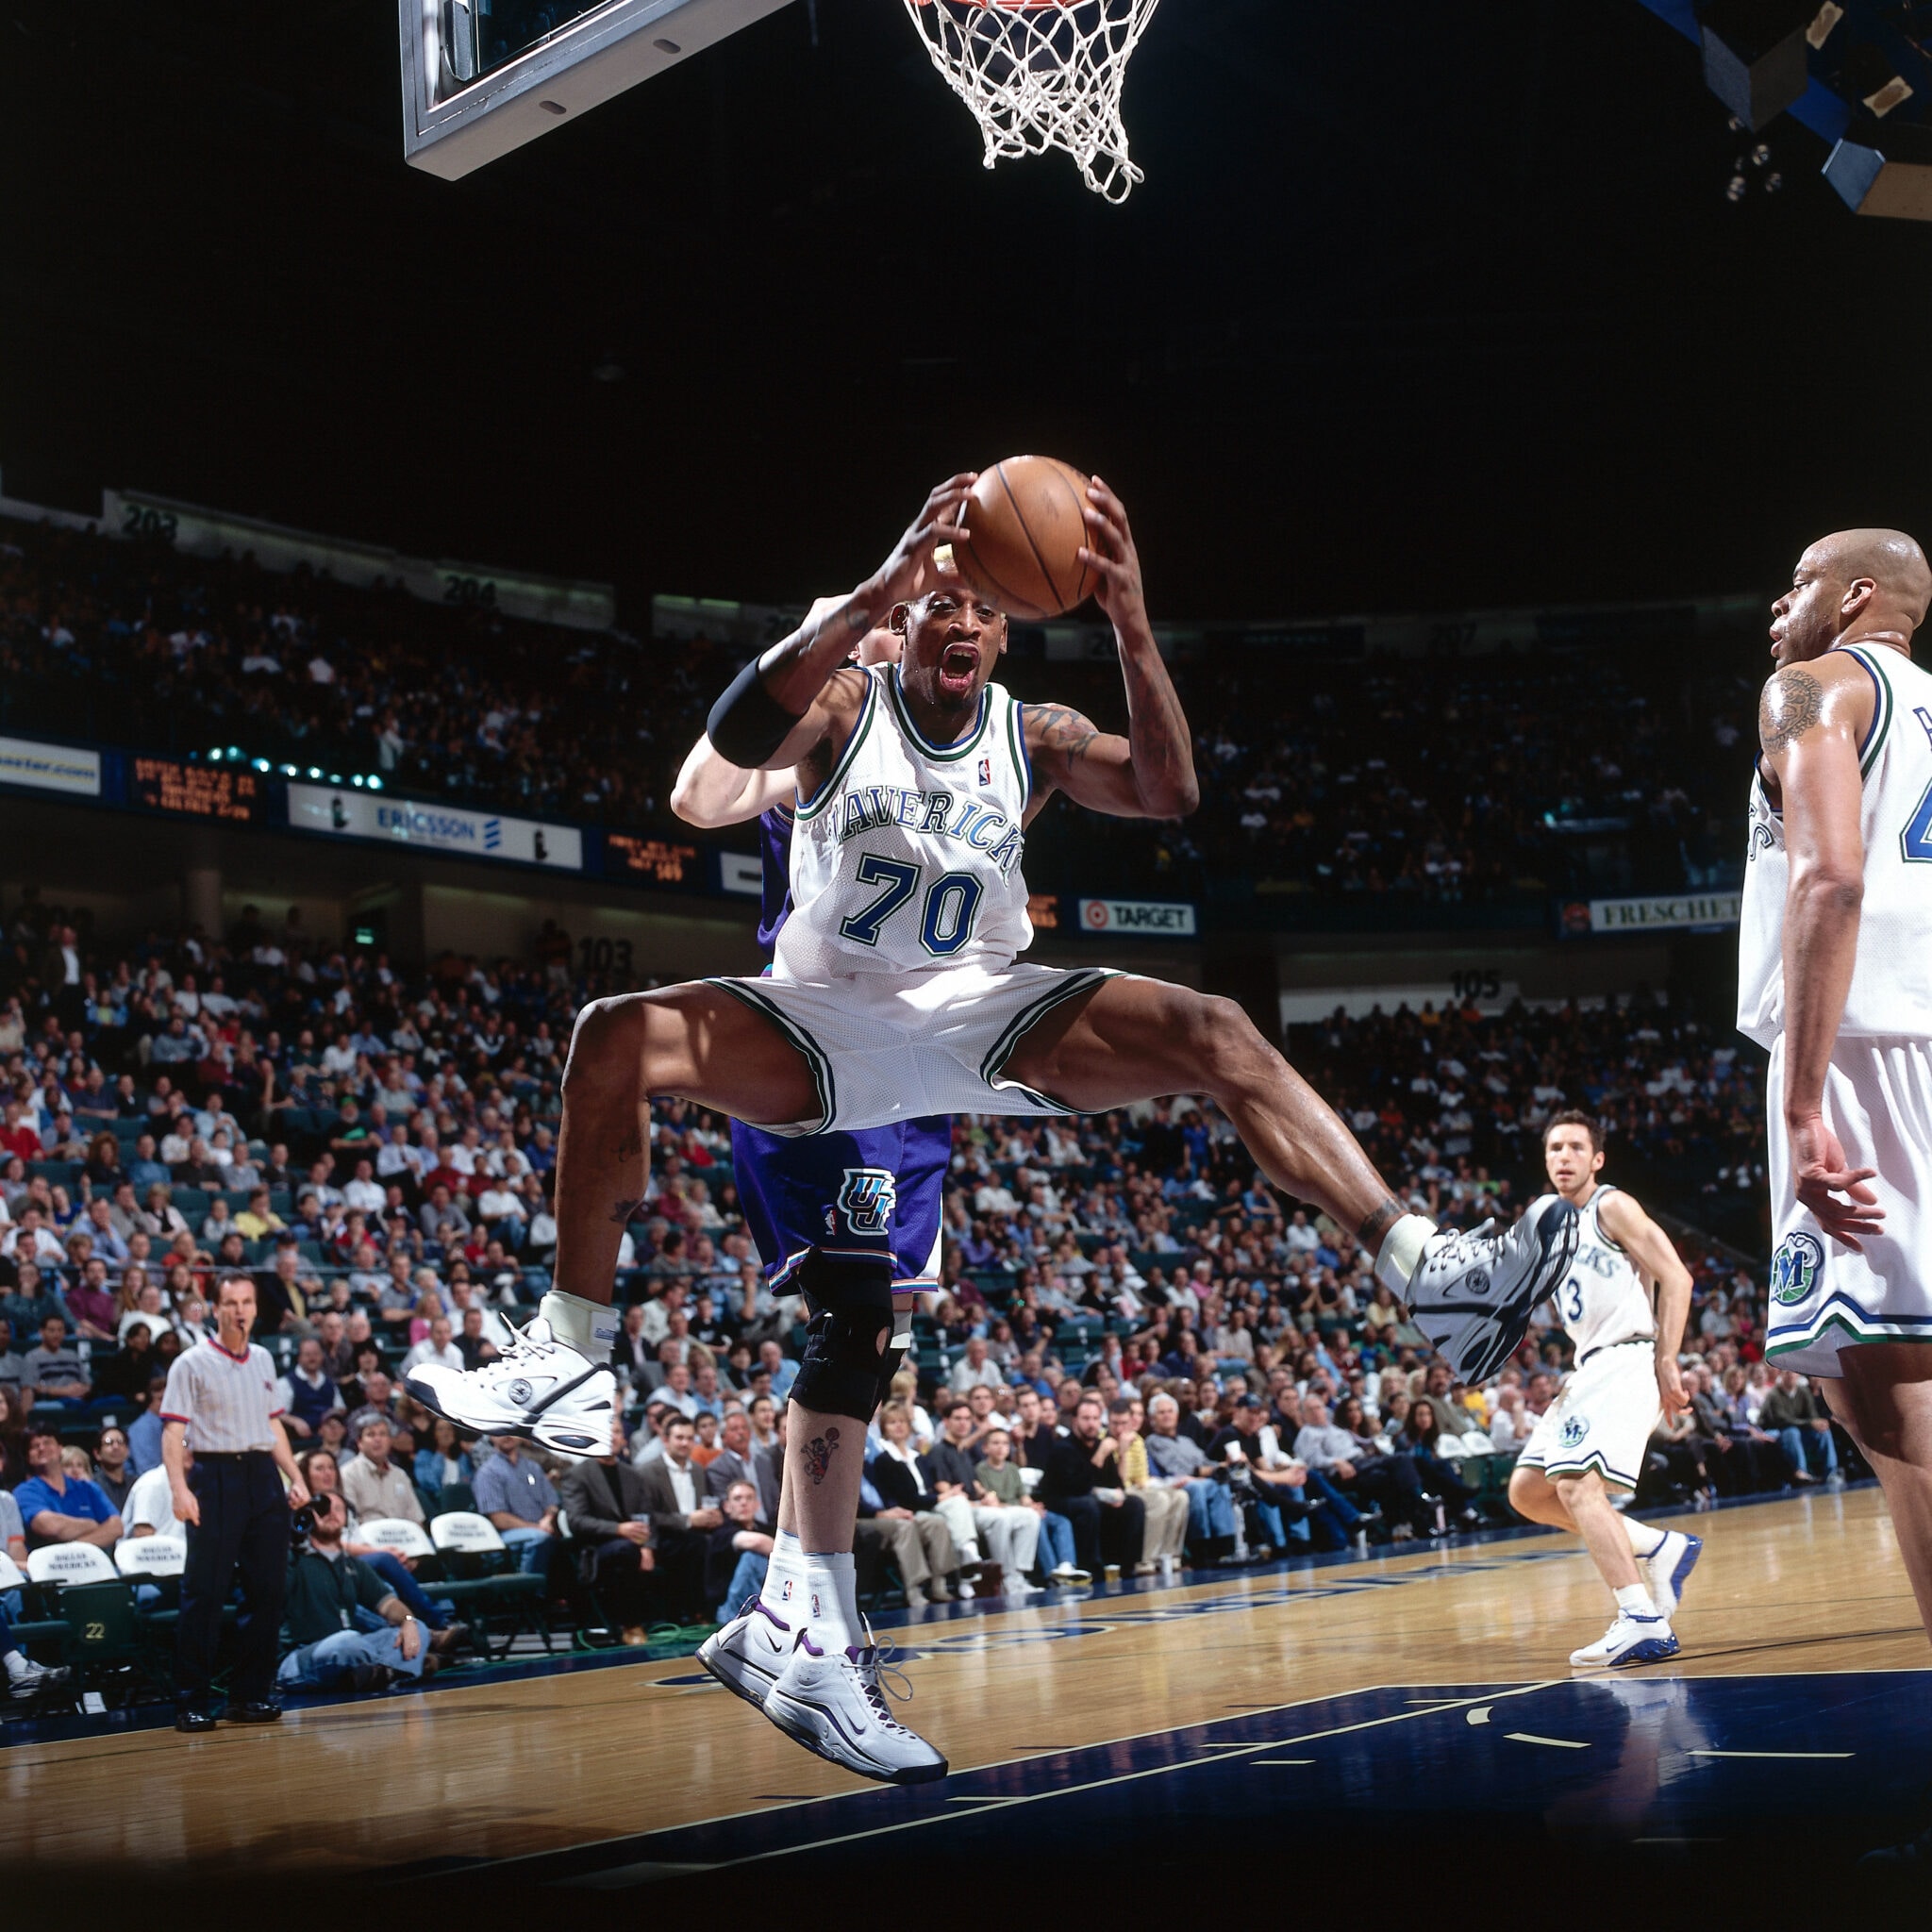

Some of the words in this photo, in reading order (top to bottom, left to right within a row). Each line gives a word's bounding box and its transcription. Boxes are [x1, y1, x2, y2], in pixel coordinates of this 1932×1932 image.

[377, 808, 475, 840] ERICSSON
[839, 852, 984, 958] 70
[1113, 906, 1187, 929] TARGET
[578, 936, 633, 976] 103
[1449, 969, 1502, 999] 105
[85, 1623, 105, 1640] 22
